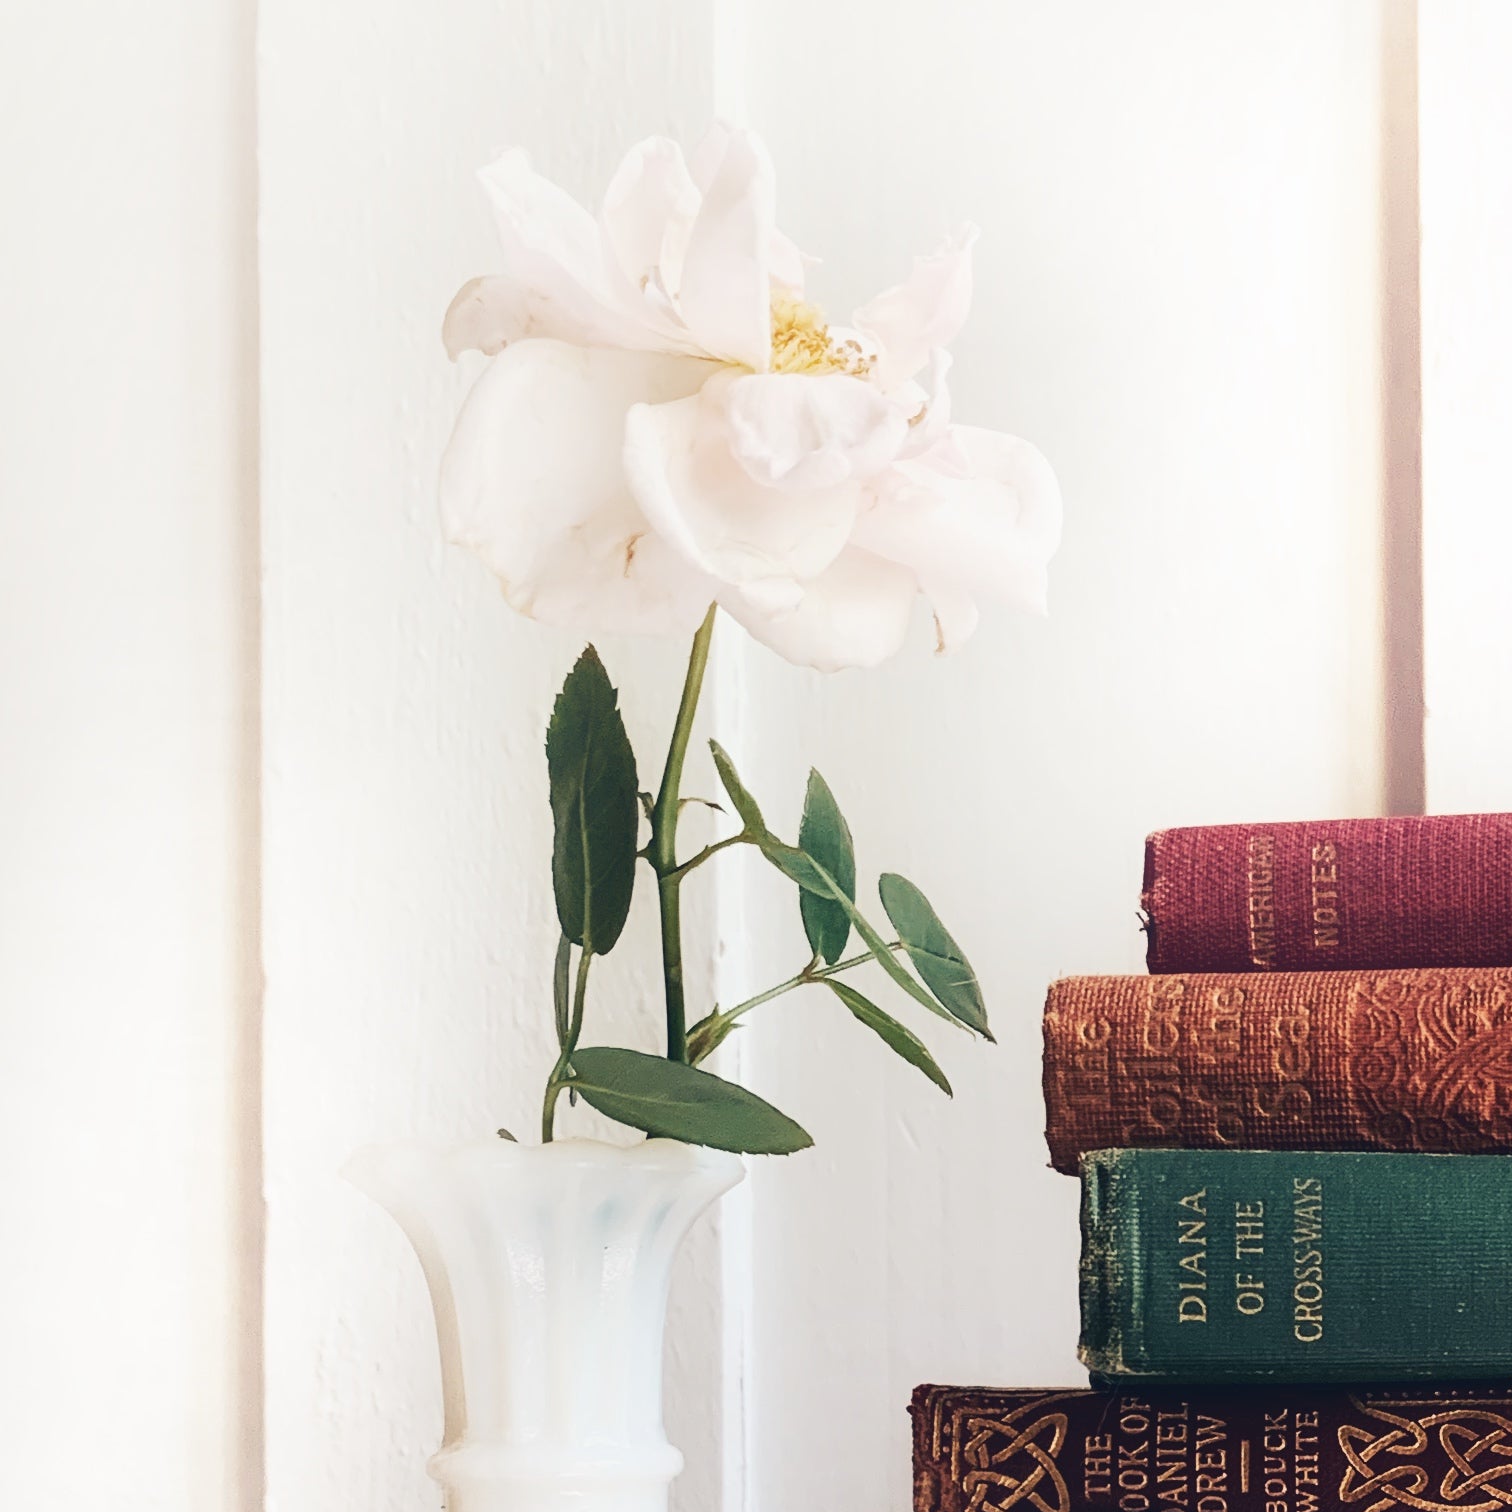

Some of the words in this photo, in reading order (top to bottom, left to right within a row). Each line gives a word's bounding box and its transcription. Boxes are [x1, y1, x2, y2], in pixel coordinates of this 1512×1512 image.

[1249, 835, 1275, 967] AMERICAN
[1312, 839, 1338, 947] NOTES
[1254, 1004, 1312, 1122] Sea
[1177, 1187, 1207, 1323] DIANA
[1235, 1200, 1264, 1260] THE
[1235, 1273, 1264, 1315] OF
[1119, 1395, 1150, 1434] OF
[1084, 1433, 1112, 1499] THE
